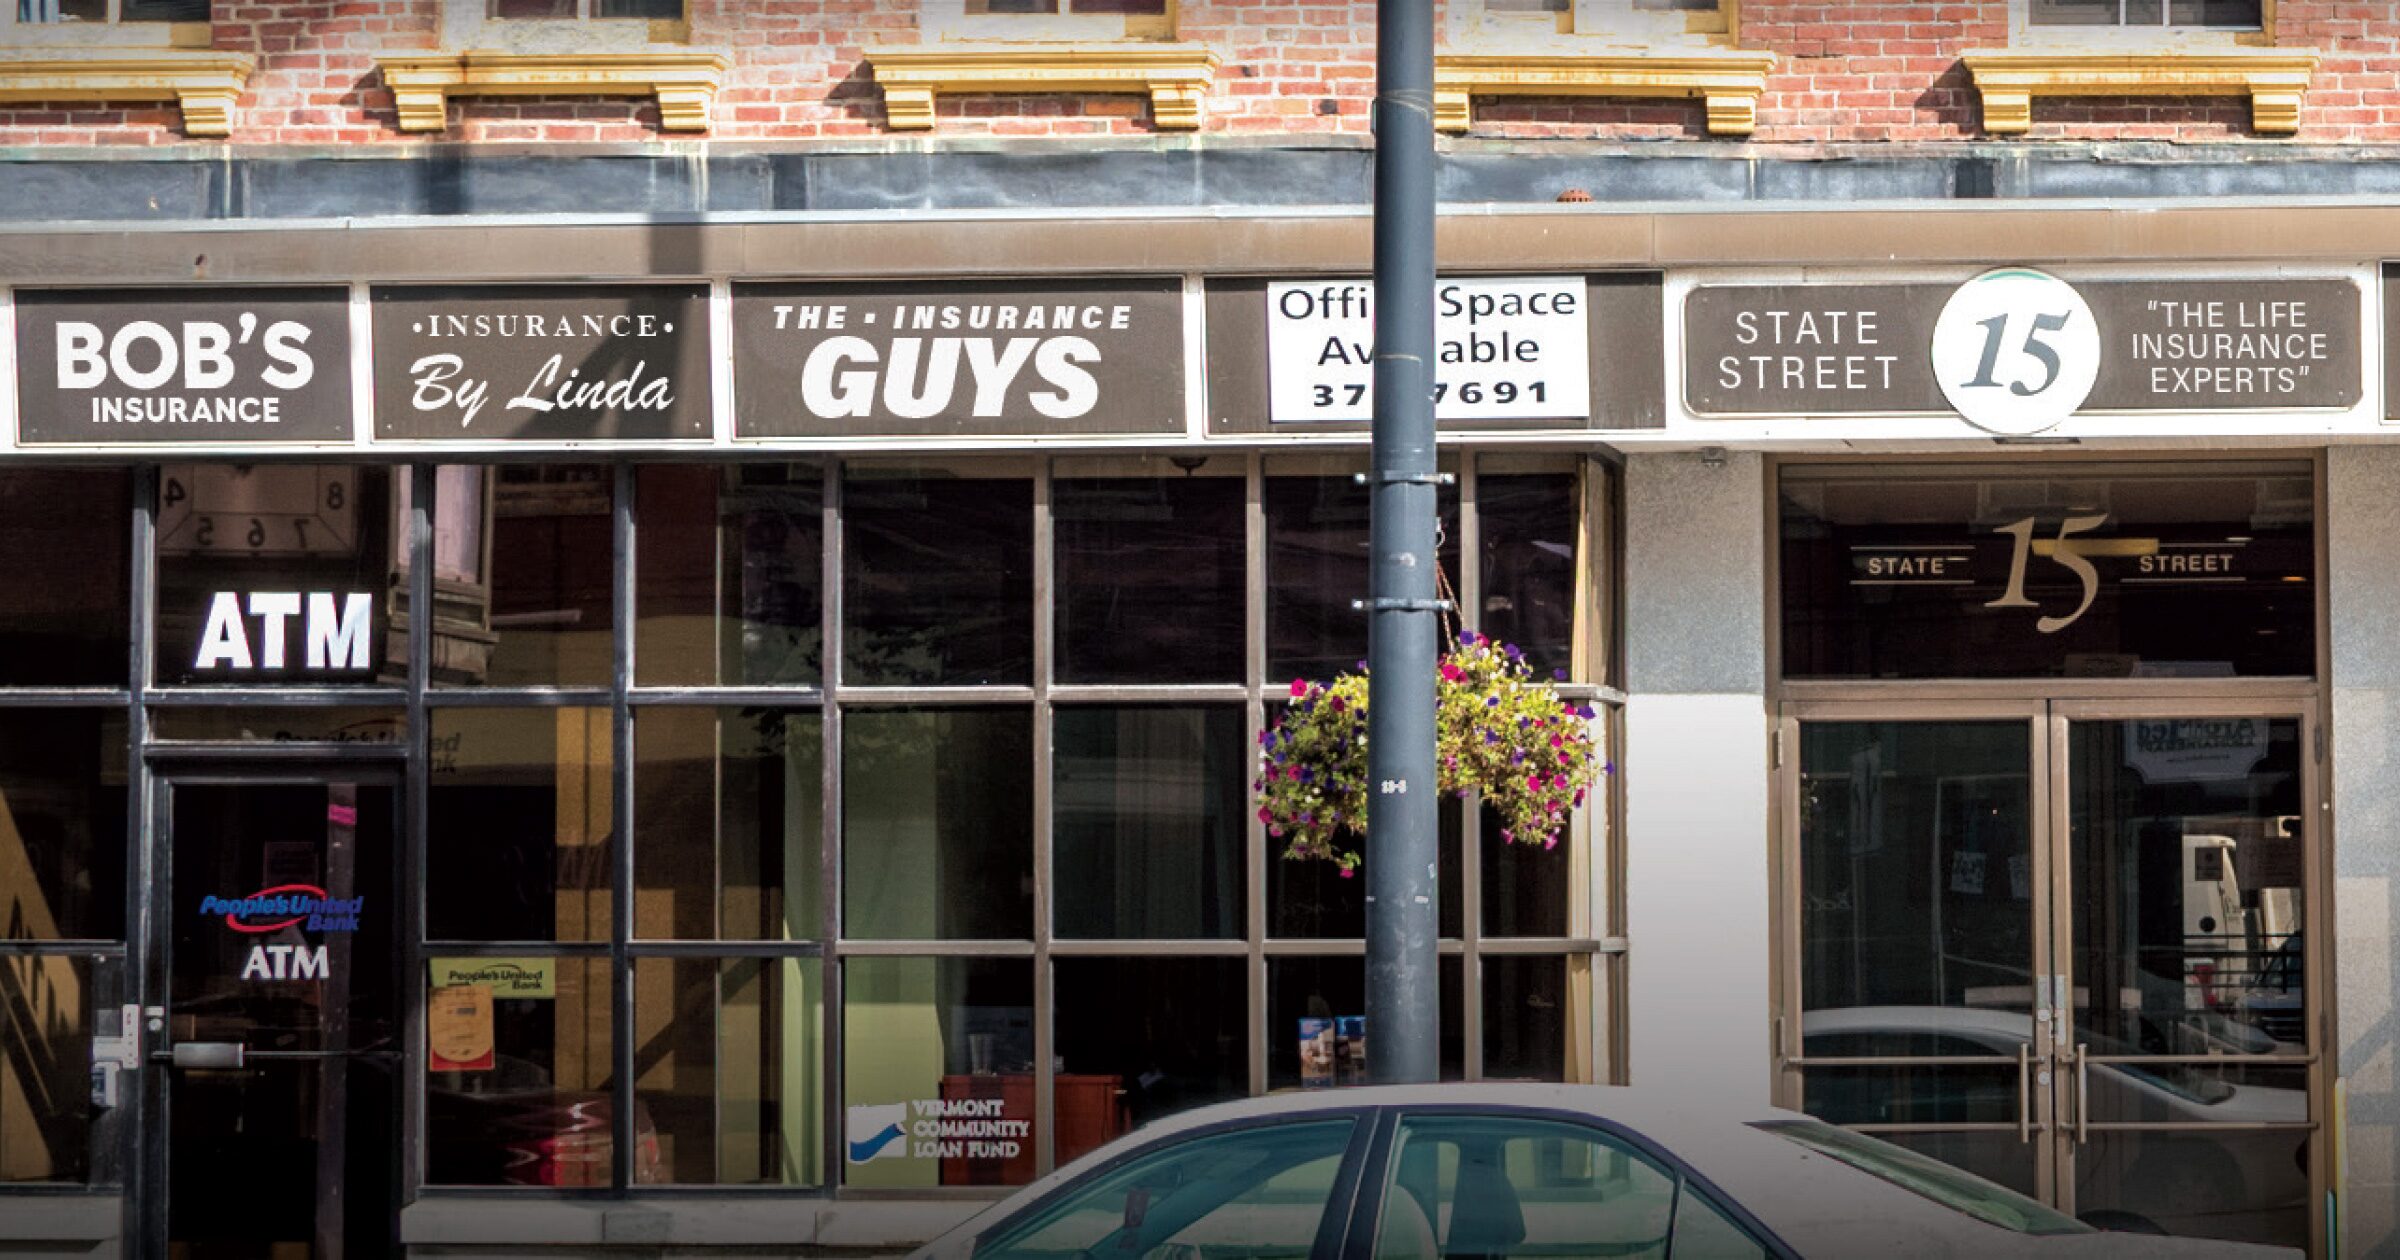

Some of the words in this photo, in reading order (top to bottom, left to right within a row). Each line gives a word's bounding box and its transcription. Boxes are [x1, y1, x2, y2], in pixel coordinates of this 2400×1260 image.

[773, 305, 848, 329] THE
[892, 305, 1132, 329] INSURANCE
[1279, 286, 1368, 320] Offi
[1440, 286, 1576, 326] Space
[2239, 301, 2307, 328] LIFE
[1735, 310, 1880, 345] STATE
[55, 311, 315, 390] BOB'S
[1317, 331, 1541, 366] Avable
[1959, 309, 2073, 397] 15
[2132, 333, 2328, 360] INSURANCE
[801, 335, 1102, 419] GUYS
[1718, 355, 1899, 390] STREET
[2150, 365, 2311, 393] EXPERTS"
[409, 353, 489, 428] By
[505, 353, 675, 413] Linda
[92, 397, 280, 423] INSURANCE
[1867, 556, 1945, 575] STATE
[1984, 513, 2109, 634] 15
[2139, 554, 2234, 573] STREET
[194, 591, 373, 670] ATM
[199, 894, 289, 919] People's
[291, 894, 365, 914] United
[306, 914, 360, 931] Bank
[241, 944, 331, 980] ATM
[501, 969, 544, 980] United
[512, 981, 542, 990] Bank
[912, 1099, 1005, 1117] VERMONT
[913, 1119, 1031, 1138] COMMUNITY
[913, 1140, 962, 1158] LOAN
[966, 1140, 1020, 1158] FUND
